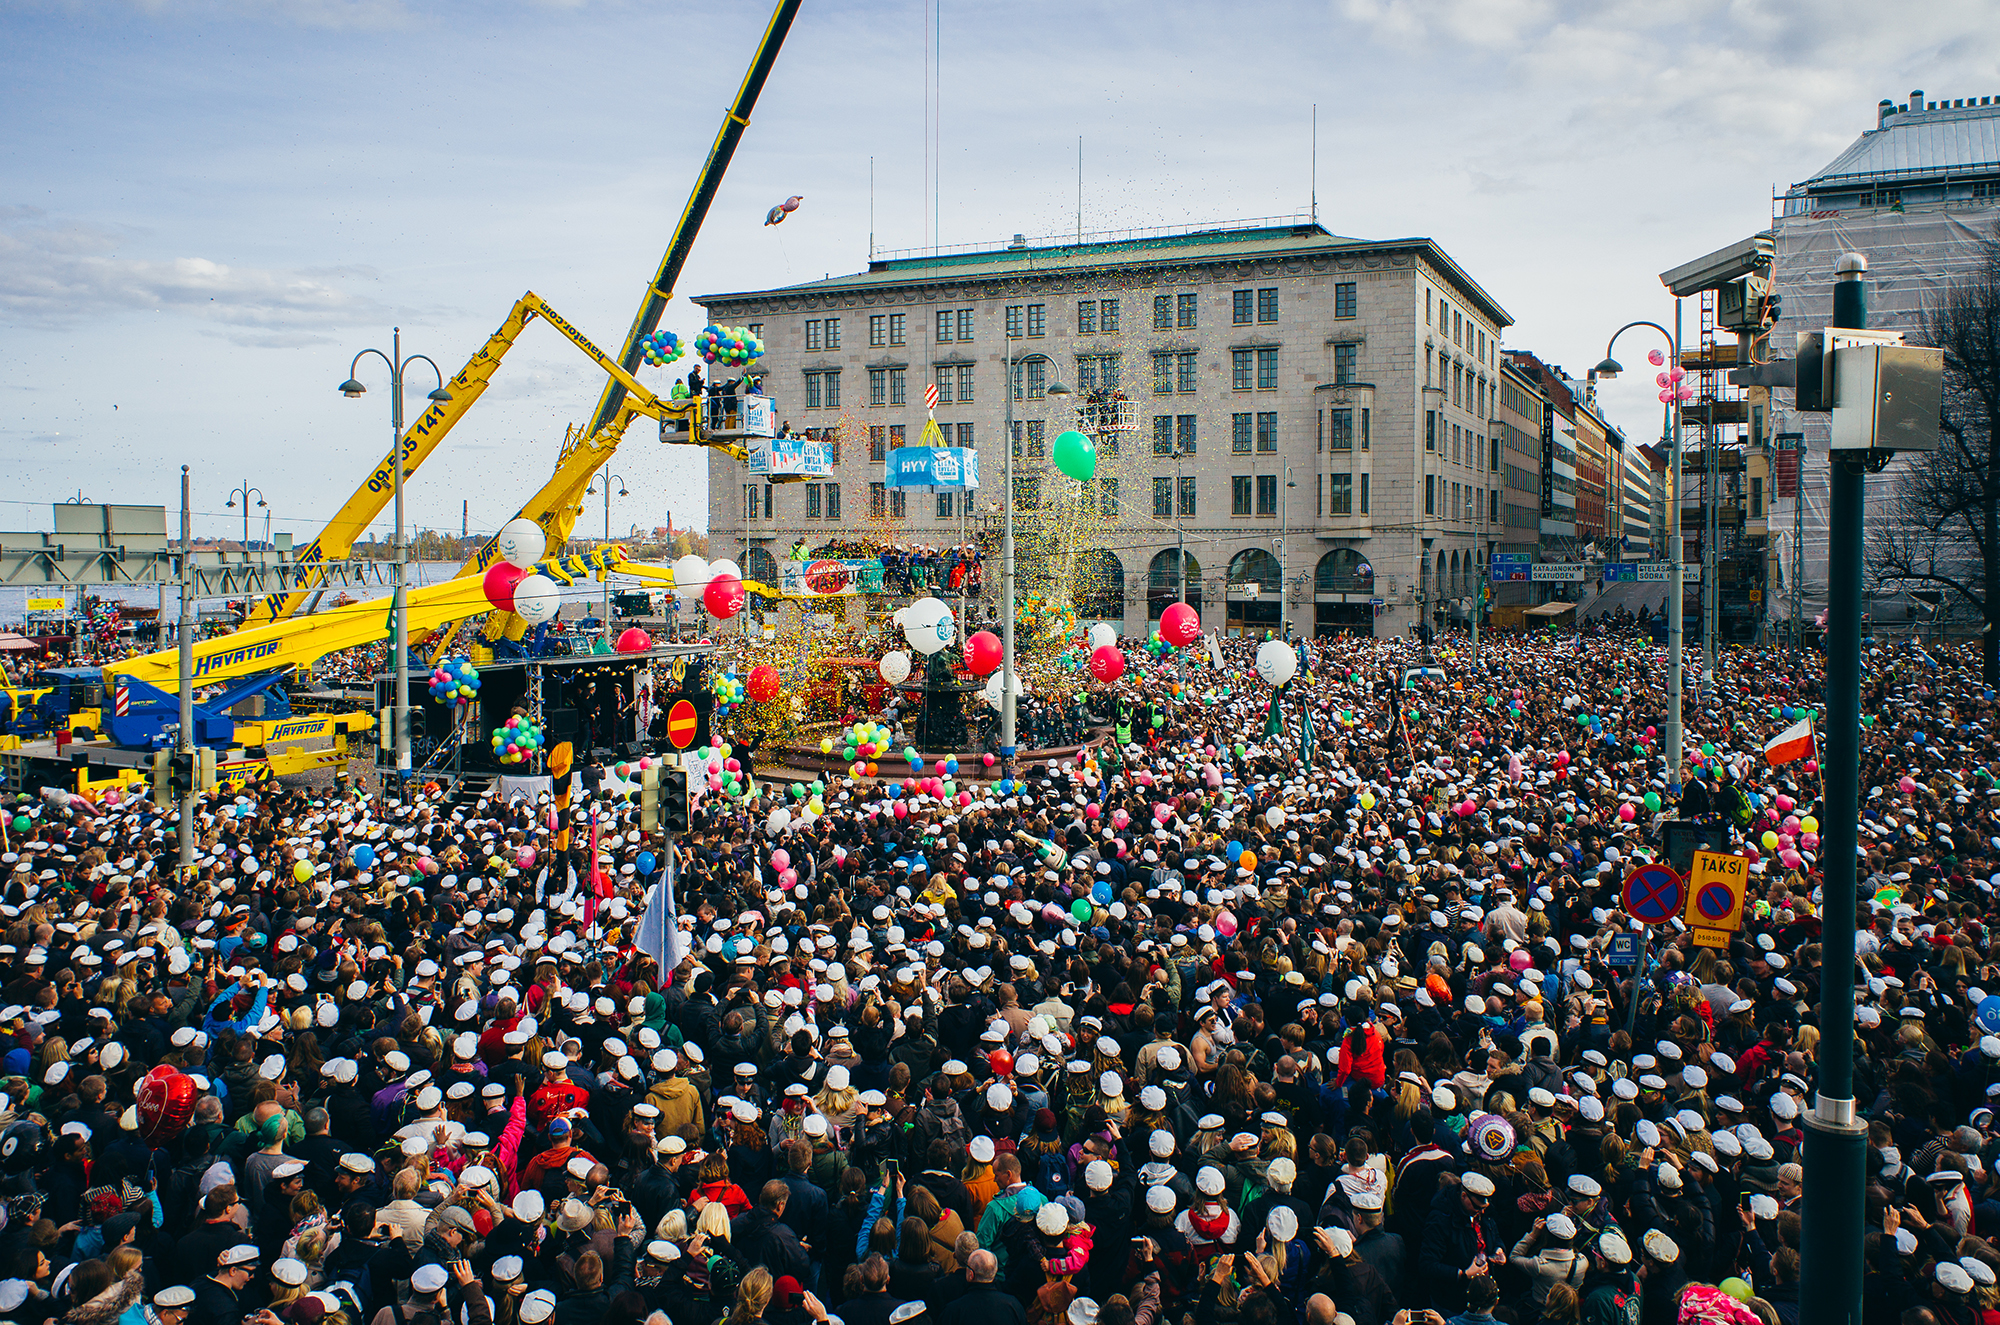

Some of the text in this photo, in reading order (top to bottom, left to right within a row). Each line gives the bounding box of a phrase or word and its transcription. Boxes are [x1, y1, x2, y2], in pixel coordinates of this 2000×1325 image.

[540, 302, 605, 362] havator.com
[416, 405, 446, 436] 141
[779, 441, 793, 452] HYY
[901, 460, 927, 473] HYY
[1544, 411, 1552, 508] HOTEL HAVEN
[1532, 572, 1575, 580] SKATUDDEN
[1638, 572, 1664, 580] SÖDRA
[192, 638, 281, 678] HAVATOR
[266, 719, 329, 741] HAVATOR
[1701, 857, 1742, 876] TAKSI
[1615, 940, 1631, 949] WC
